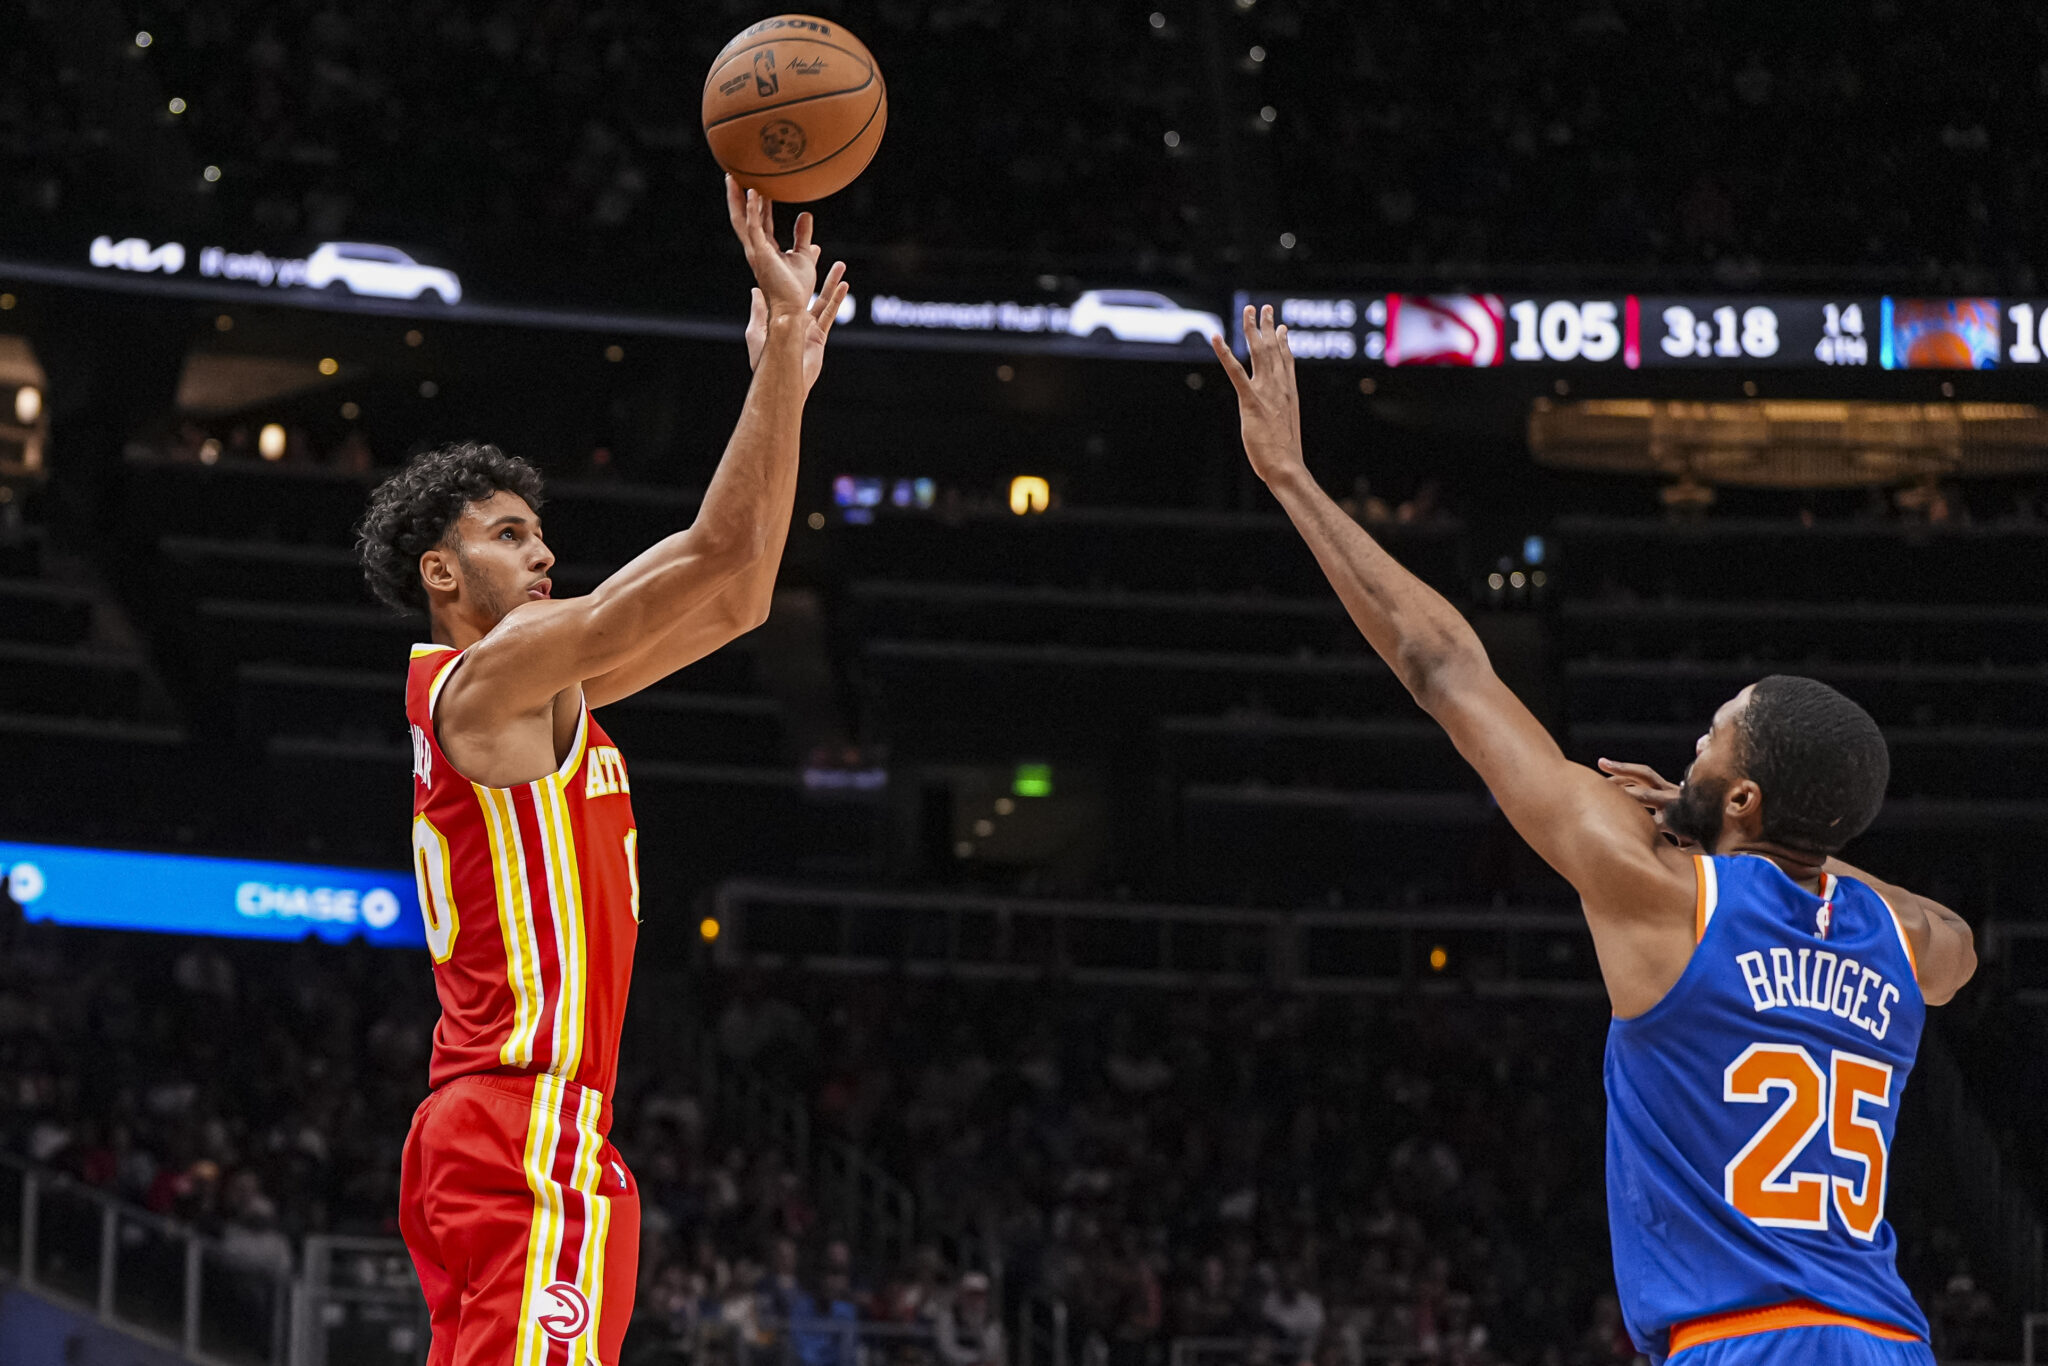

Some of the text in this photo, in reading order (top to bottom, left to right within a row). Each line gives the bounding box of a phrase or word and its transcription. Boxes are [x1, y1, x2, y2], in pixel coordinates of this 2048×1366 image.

[871, 295, 994, 330] Movement
[1282, 299, 1357, 328] FOULS
[1510, 300, 1621, 362] 105
[1660, 306, 1780, 358] 3:18
[1822, 303, 1864, 337] 14
[2008, 303, 2048, 363] 1
[1814, 335, 1868, 366] 4TH
[235, 881, 358, 923] CHASE
[1736, 947, 1900, 1041] BRIDGES
[1724, 1042, 1893, 1242] 25
